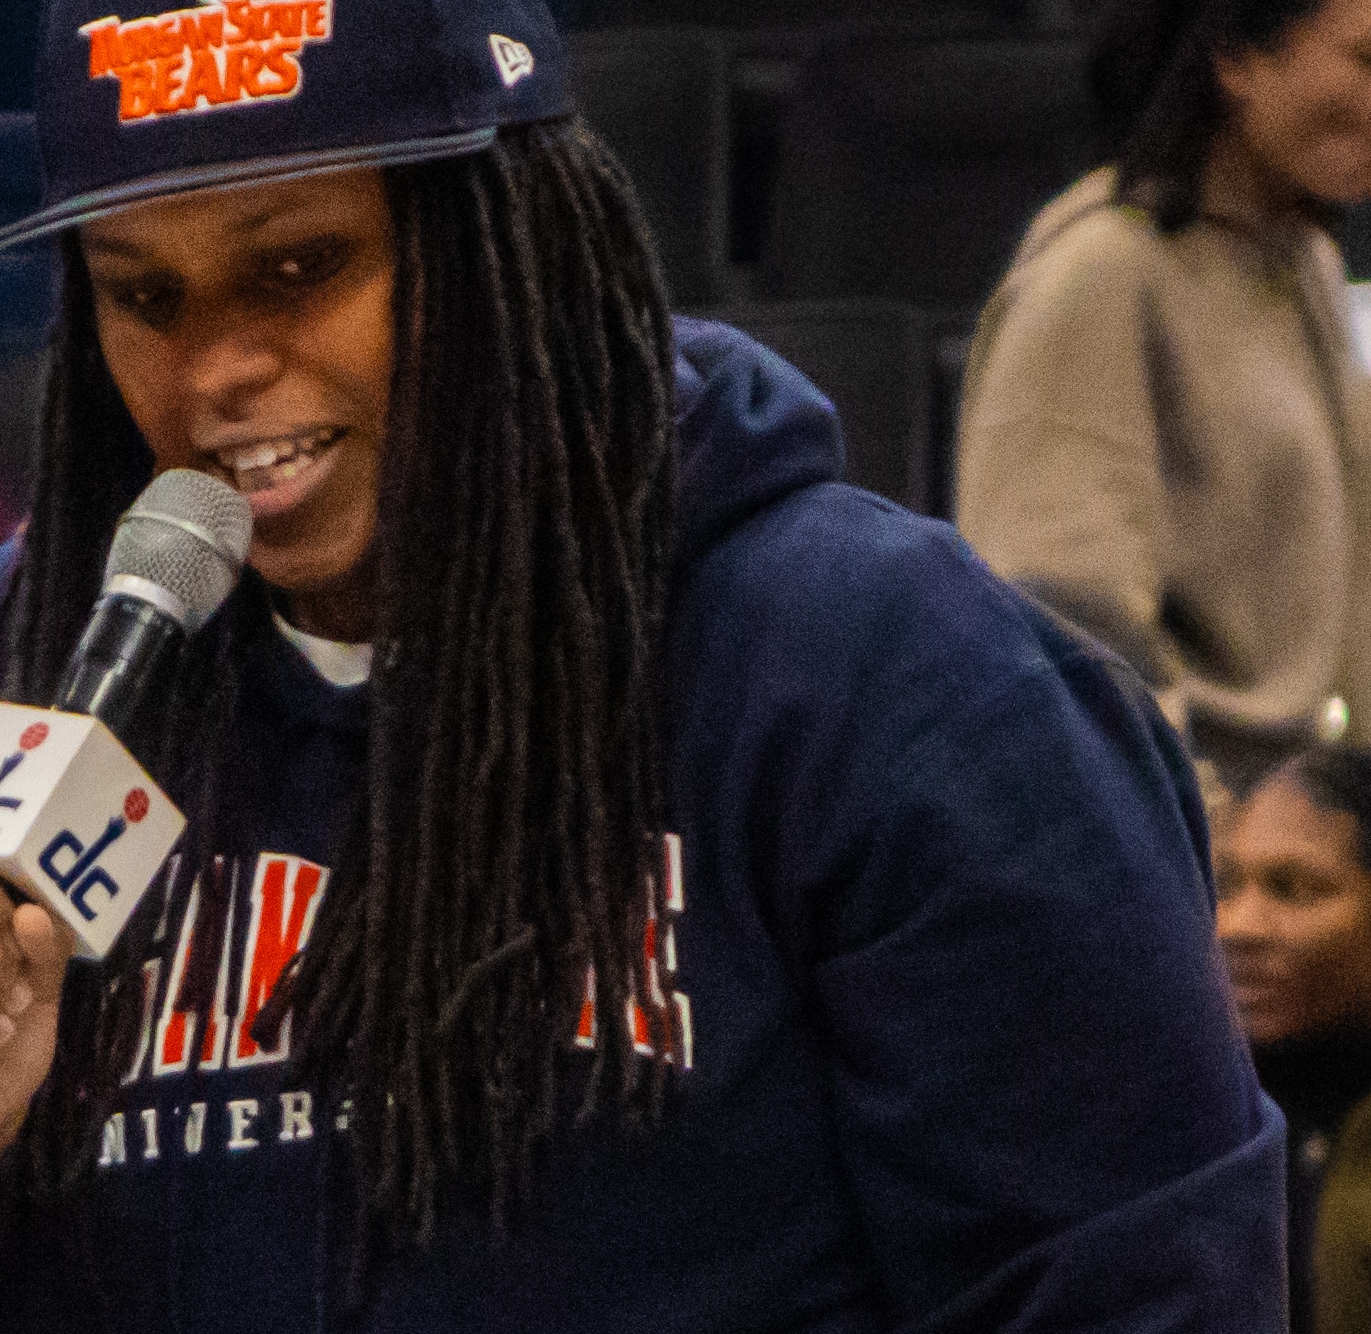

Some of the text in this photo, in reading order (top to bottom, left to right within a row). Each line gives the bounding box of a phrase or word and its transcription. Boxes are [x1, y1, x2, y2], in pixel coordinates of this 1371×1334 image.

[78, 3, 226, 79] MORGAN
[118, 39, 304, 126] BEARS
[38, 811, 120, 922] dc
